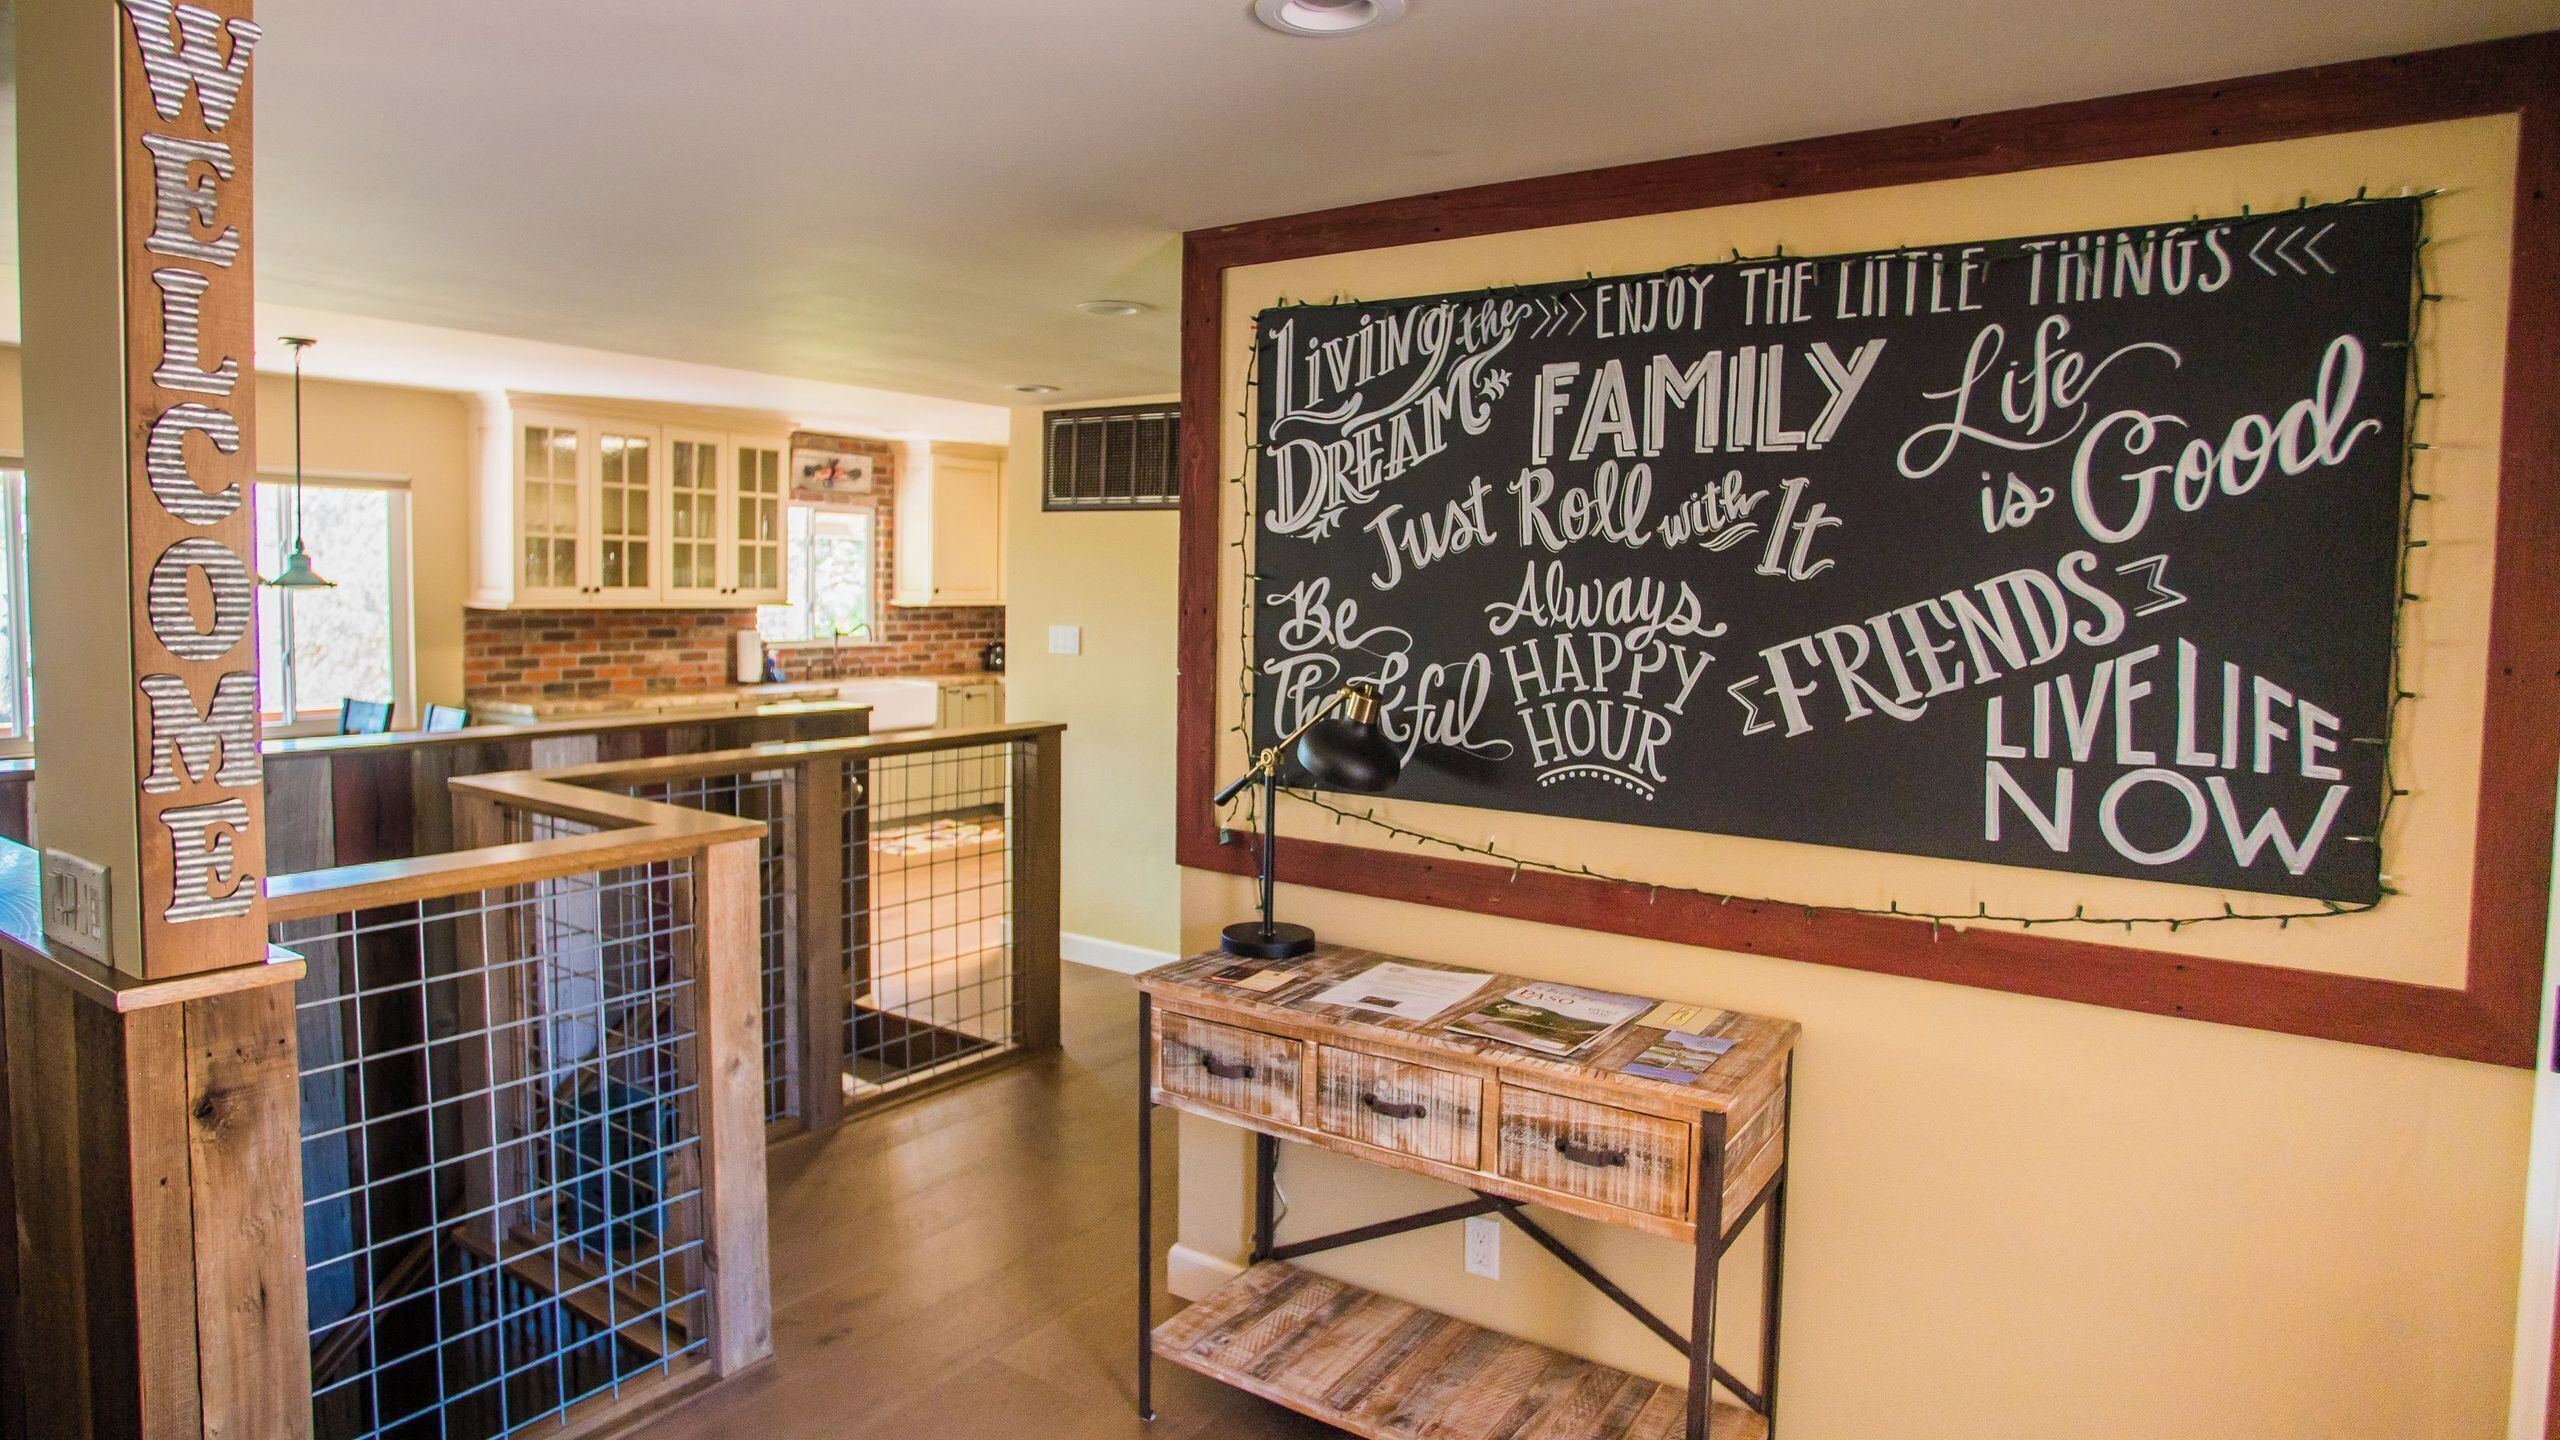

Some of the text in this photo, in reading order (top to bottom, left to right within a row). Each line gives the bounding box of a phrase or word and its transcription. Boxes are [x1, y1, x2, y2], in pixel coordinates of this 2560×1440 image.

[1455, 299, 1533, 353] the
[1597, 226, 2231, 339] ENJOY THE LITTLE THINGS
[1265, 353, 1500, 534] DREAM
[1532, 338, 1888, 464] FAMILY
[1897, 314, 2181, 479] Life
[1981, 334, 2381, 543] is Good
[122, 0, 263, 924] WELCOME
[1363, 459, 1843, 590] Just Roll with It
[1266, 576, 1413, 655] Be
[1485, 560, 1728, 651] Always
[1758, 550, 2126, 738] FRIENDS
[1263, 651, 1514, 770] Thakful
[1500, 632, 1716, 715] HAPPY
[1987, 637, 2342, 780] LIVE LIFE
[1517, 699, 1673, 782] HOUR
[1985, 760, 2350, 876] NOW
